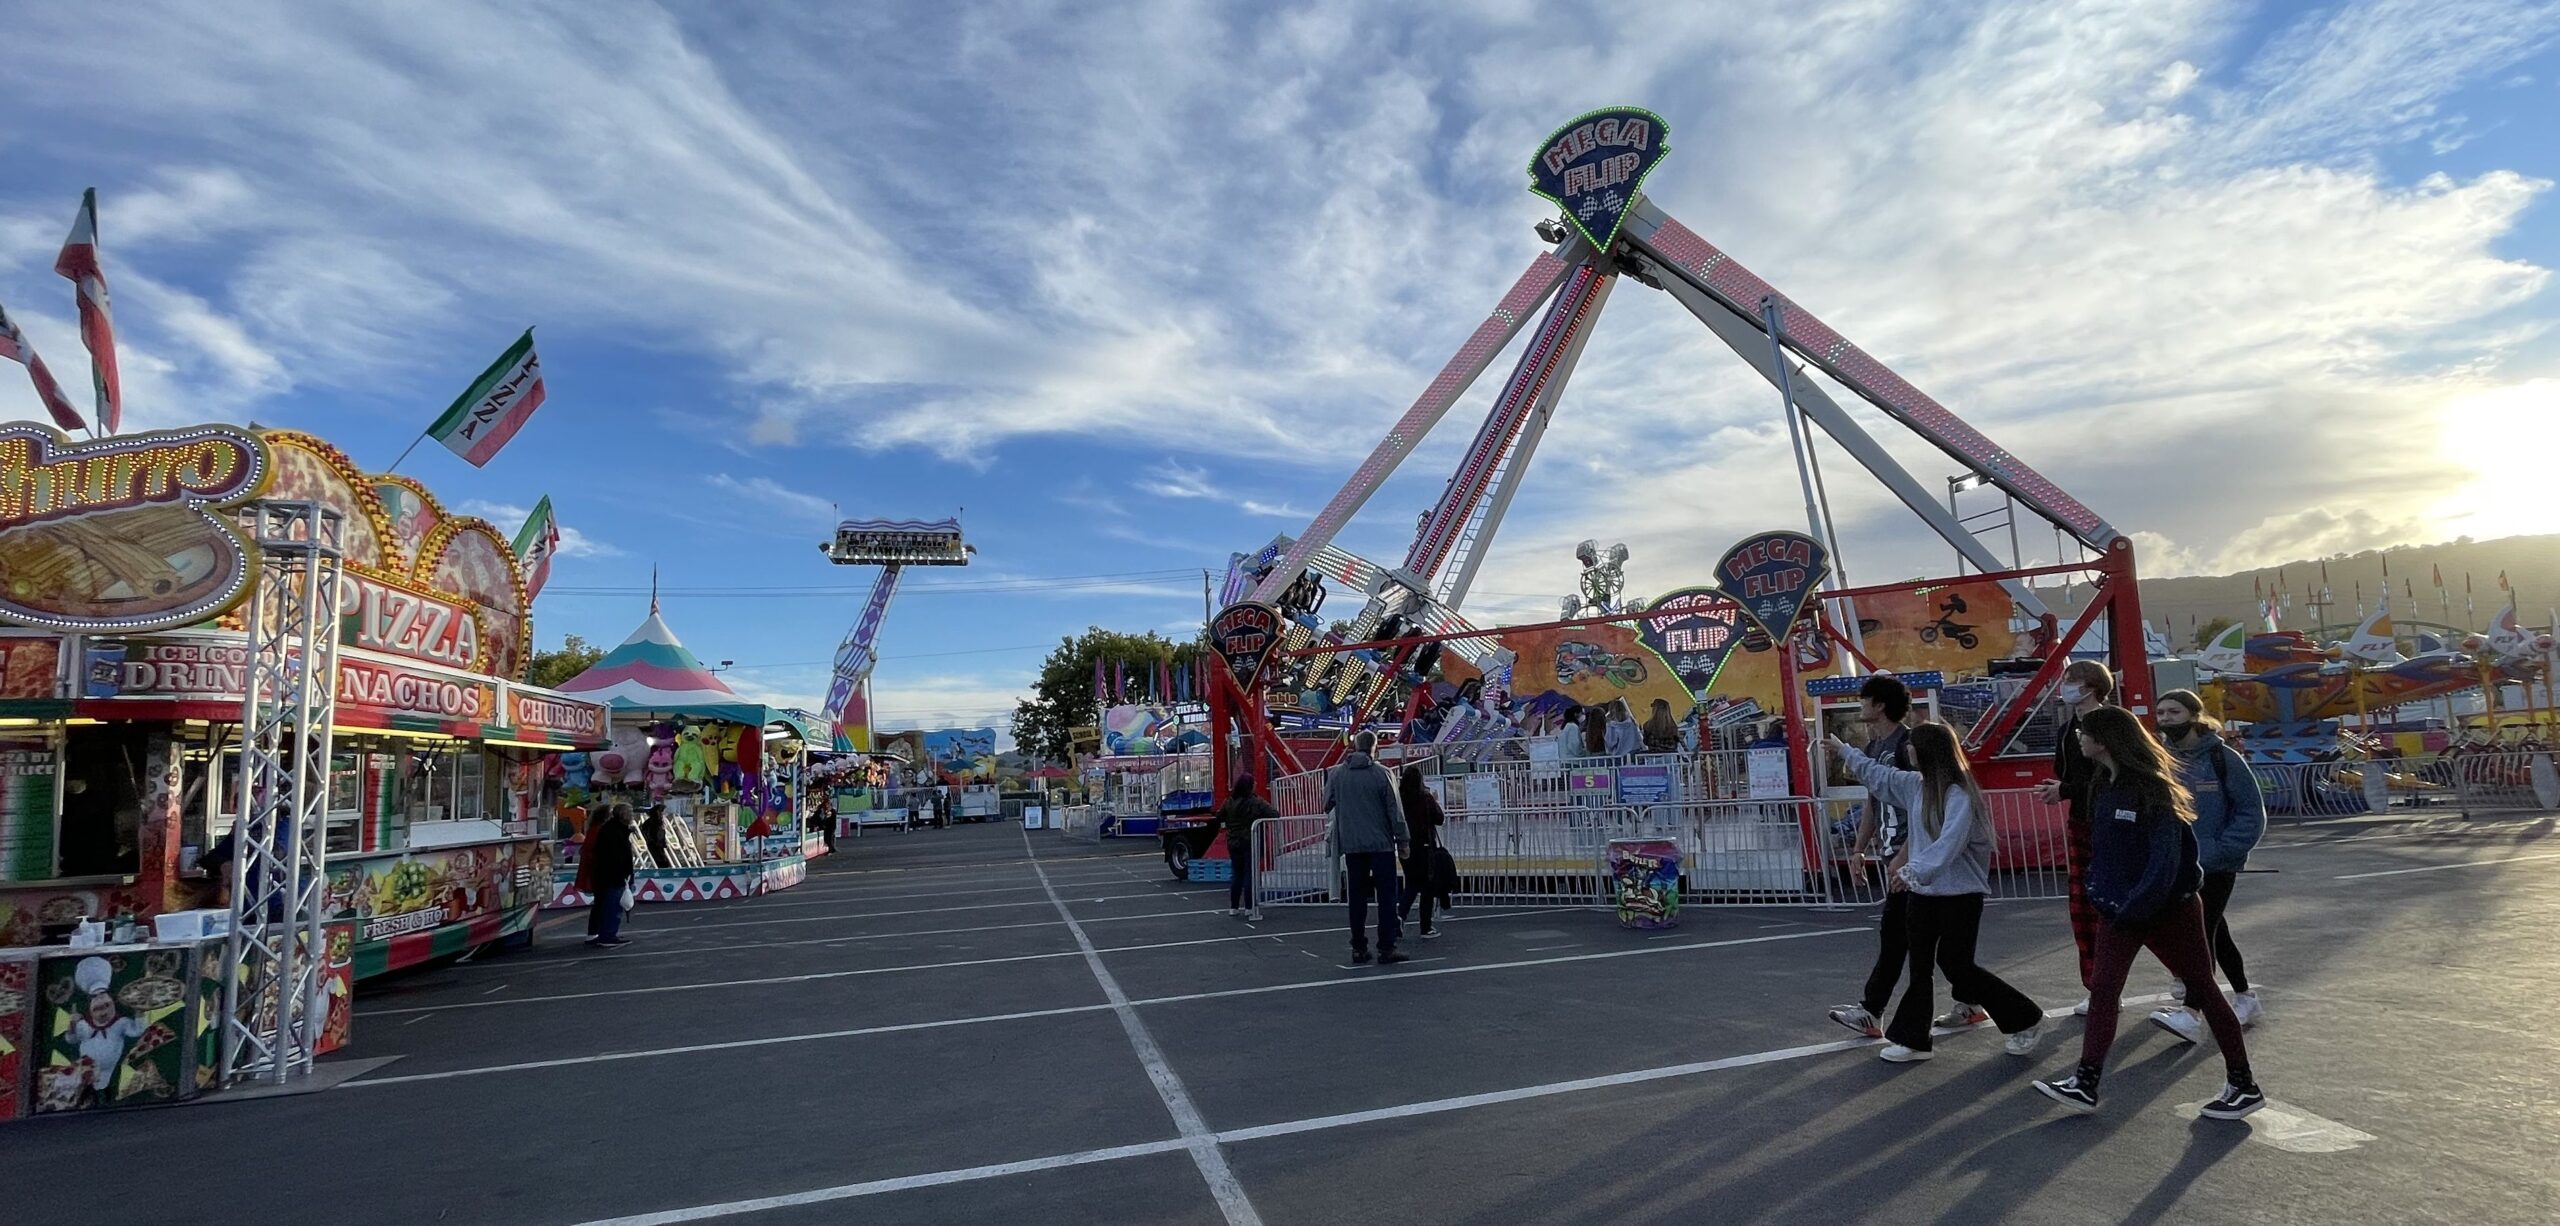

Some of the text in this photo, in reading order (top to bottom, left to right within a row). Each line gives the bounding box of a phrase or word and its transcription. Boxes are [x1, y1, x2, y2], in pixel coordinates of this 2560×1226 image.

[1543, 118, 1650, 176] MEGA
[1564, 152, 1640, 197] FLIP
[0, 438, 236, 518] hurro
[1726, 538, 1811, 581] MEGA
[1744, 568, 1806, 599] FLIP
[1215, 608, 1271, 639] MEGA
[1649, 594, 1737, 634] MEGA
[144, 645, 276, 663] ICE COD
[1226, 633, 1266, 655] FLIP
[1665, 625, 1730, 653] FLIP
[341, 667, 481, 717] NACHOS
[518, 697, 596, 731] CHURROS
[1406, 746, 1431, 757] EXIT
[1585, 776, 1594, 788] 5
[363, 907, 450, 939] FRESH & HOT
